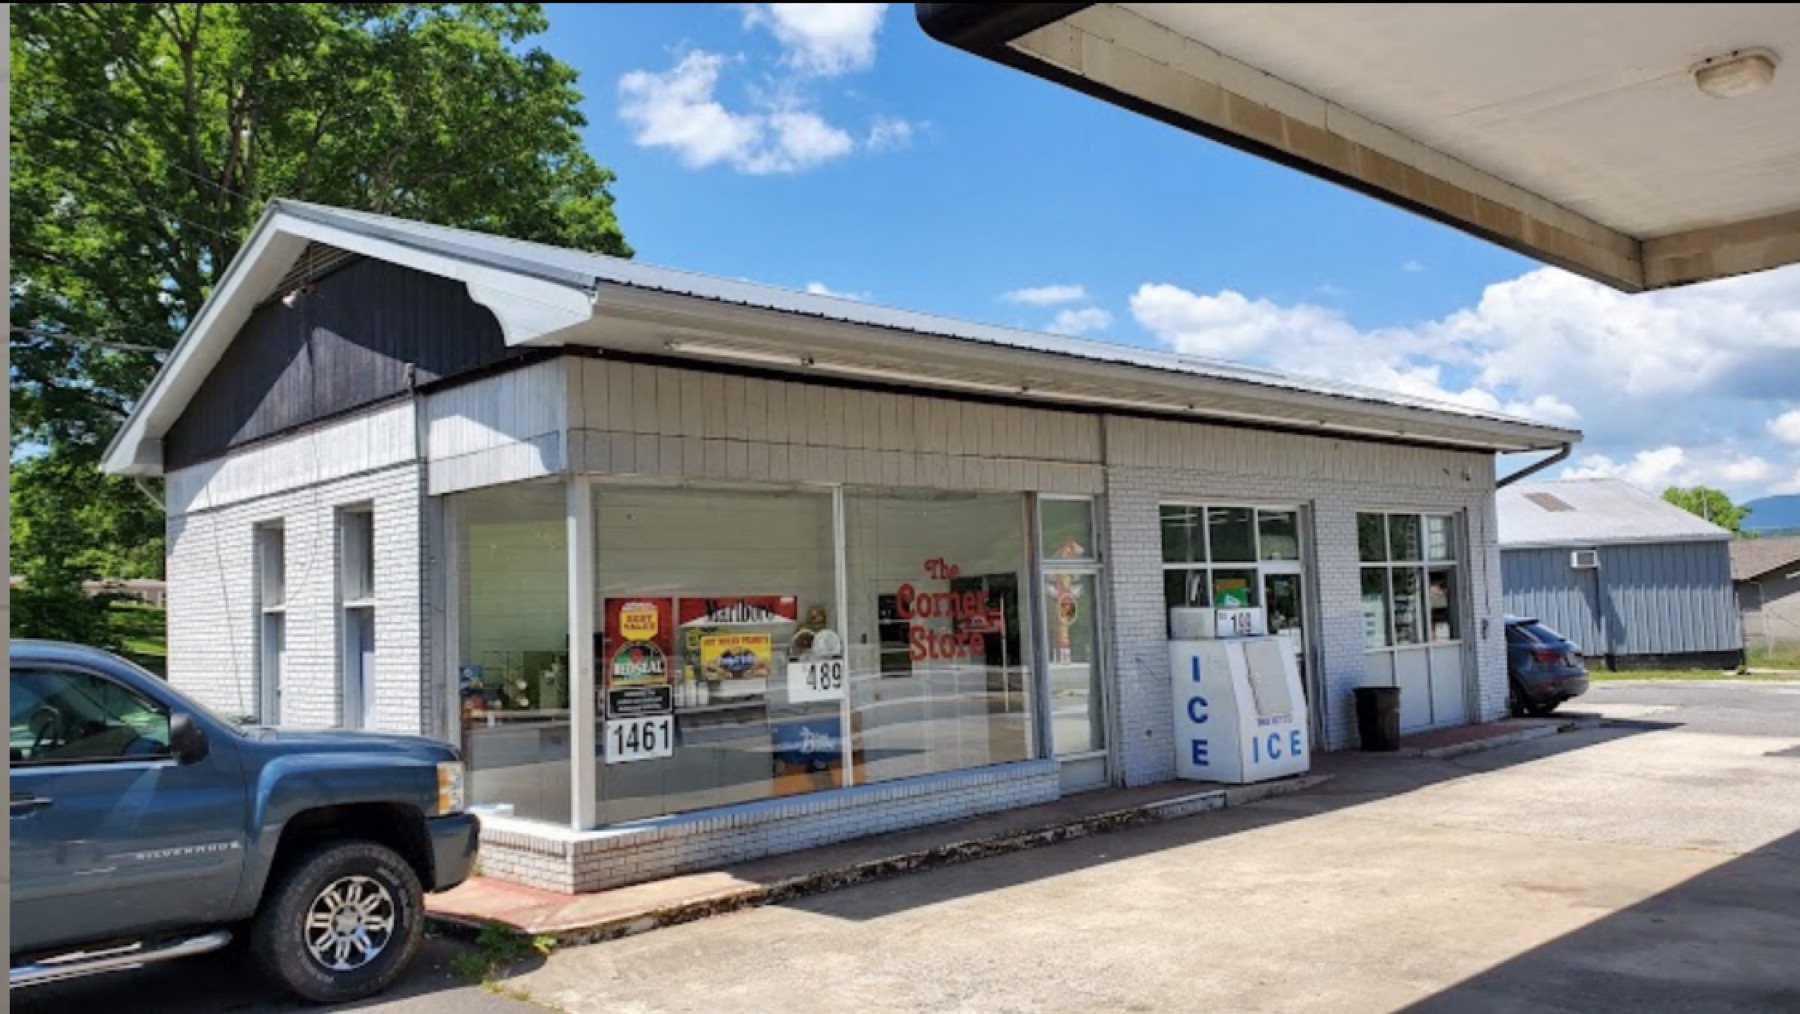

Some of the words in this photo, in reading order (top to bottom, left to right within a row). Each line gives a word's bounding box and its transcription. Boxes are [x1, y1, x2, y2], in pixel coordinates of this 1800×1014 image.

[924, 556, 960, 580] The
[626, 614, 653, 622] BEST
[705, 597, 775, 623] Marlboro
[896, 583, 988, 620] Corner
[908, 624, 984, 662] Store
[1186, 655, 1209, 766] ICE
[613, 719, 669, 756] 1461
[1252, 730, 1302, 764] ICE
[136, 842, 229, 860] SILVERADO
